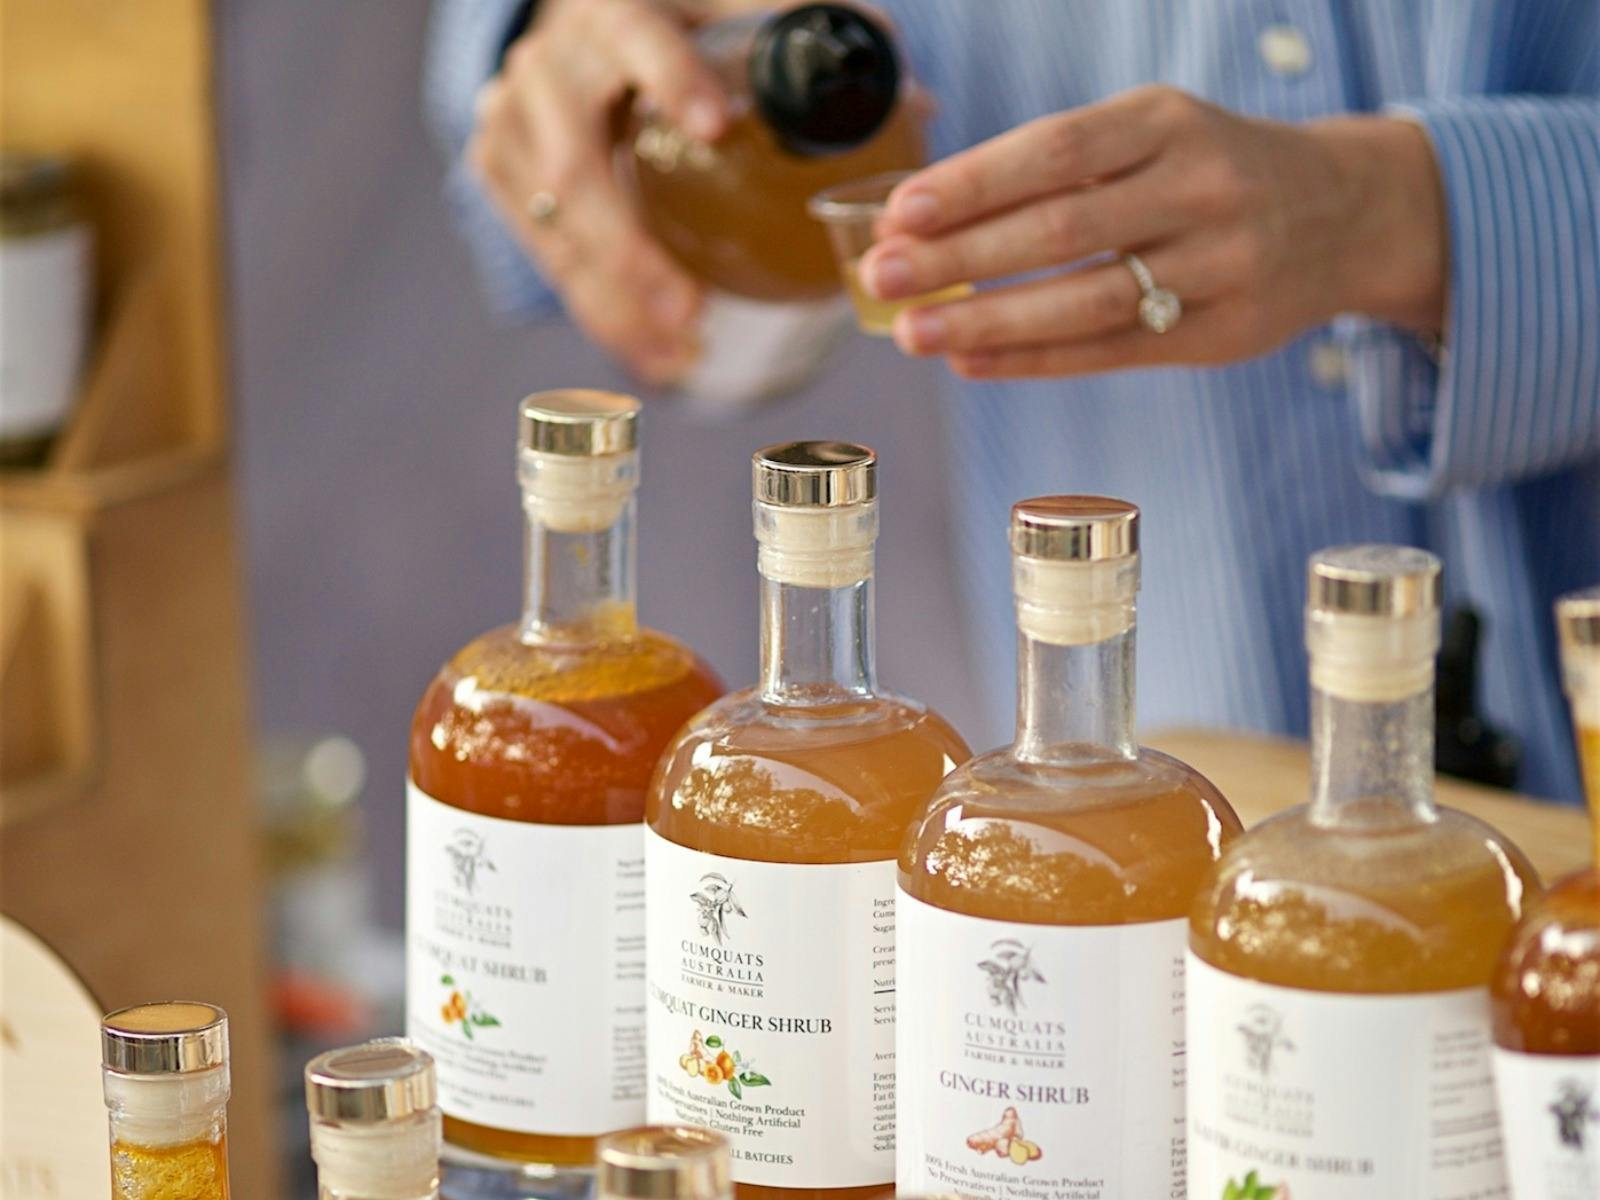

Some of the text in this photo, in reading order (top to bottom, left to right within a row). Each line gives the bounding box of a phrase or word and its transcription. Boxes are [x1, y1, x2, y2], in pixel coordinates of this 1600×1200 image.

[681, 939, 764, 966] CUMQUATS
[482, 960, 548, 984] SHRUB
[681, 957, 764, 982] AUSTRALIA
[681, 974, 764, 998] FARMER & MAKER
[699, 1005, 764, 1031] GINGER
[768, 1016, 832, 1034] SHRUB
[964, 1011, 1066, 1036] CUMQUATS
[965, 1031, 1066, 1052] AUSTRALIA
[940, 1069, 1090, 1105] GINGER SHRUB
[715, 1107, 754, 1128] Nothing
[756, 1115, 801, 1129] Artificial
[729, 1099, 762, 1114] Grown
[764, 1104, 806, 1117] Product
[742, 1124, 764, 1138] Free
[744, 1150, 794, 1165] BATCHES
[1061, 1176, 1105, 1188] Product
